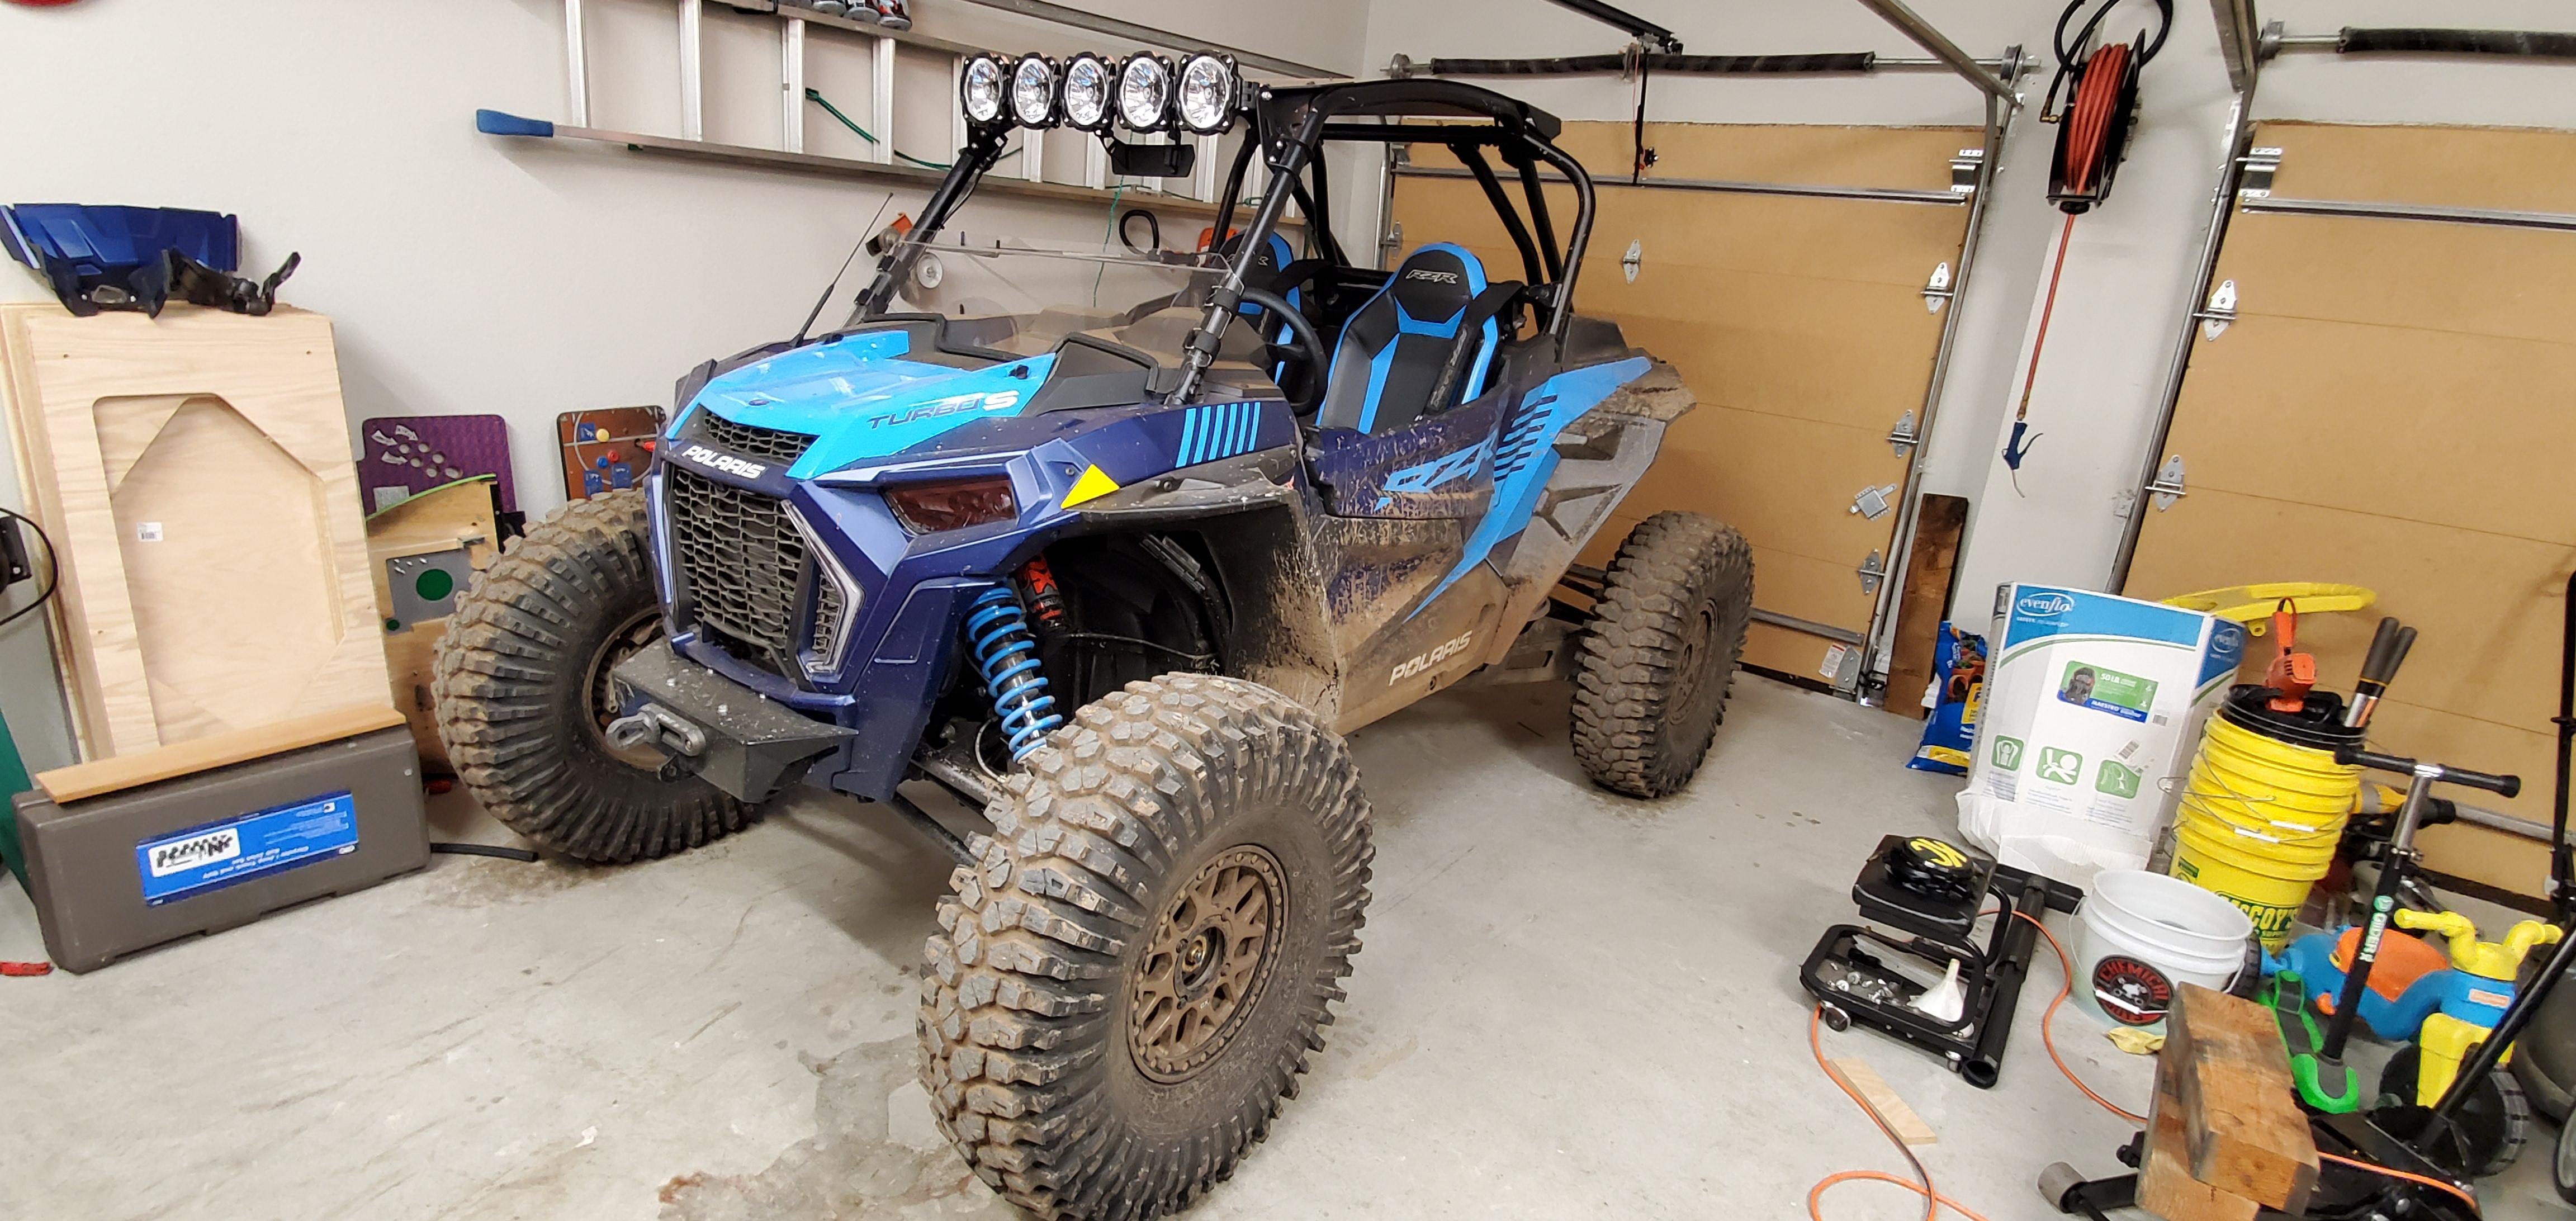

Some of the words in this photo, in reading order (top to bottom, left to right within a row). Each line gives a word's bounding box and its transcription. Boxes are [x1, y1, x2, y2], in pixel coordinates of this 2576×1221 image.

[1405, 269, 1458, 284] RZR
[866, 398, 981, 429] TURBO
[983, 390, 1020, 411] S
[681, 445, 766, 479] POLARIS
[2020, 597, 2073, 613] evenflo
[1389, 630, 1472, 686] POLARIS
